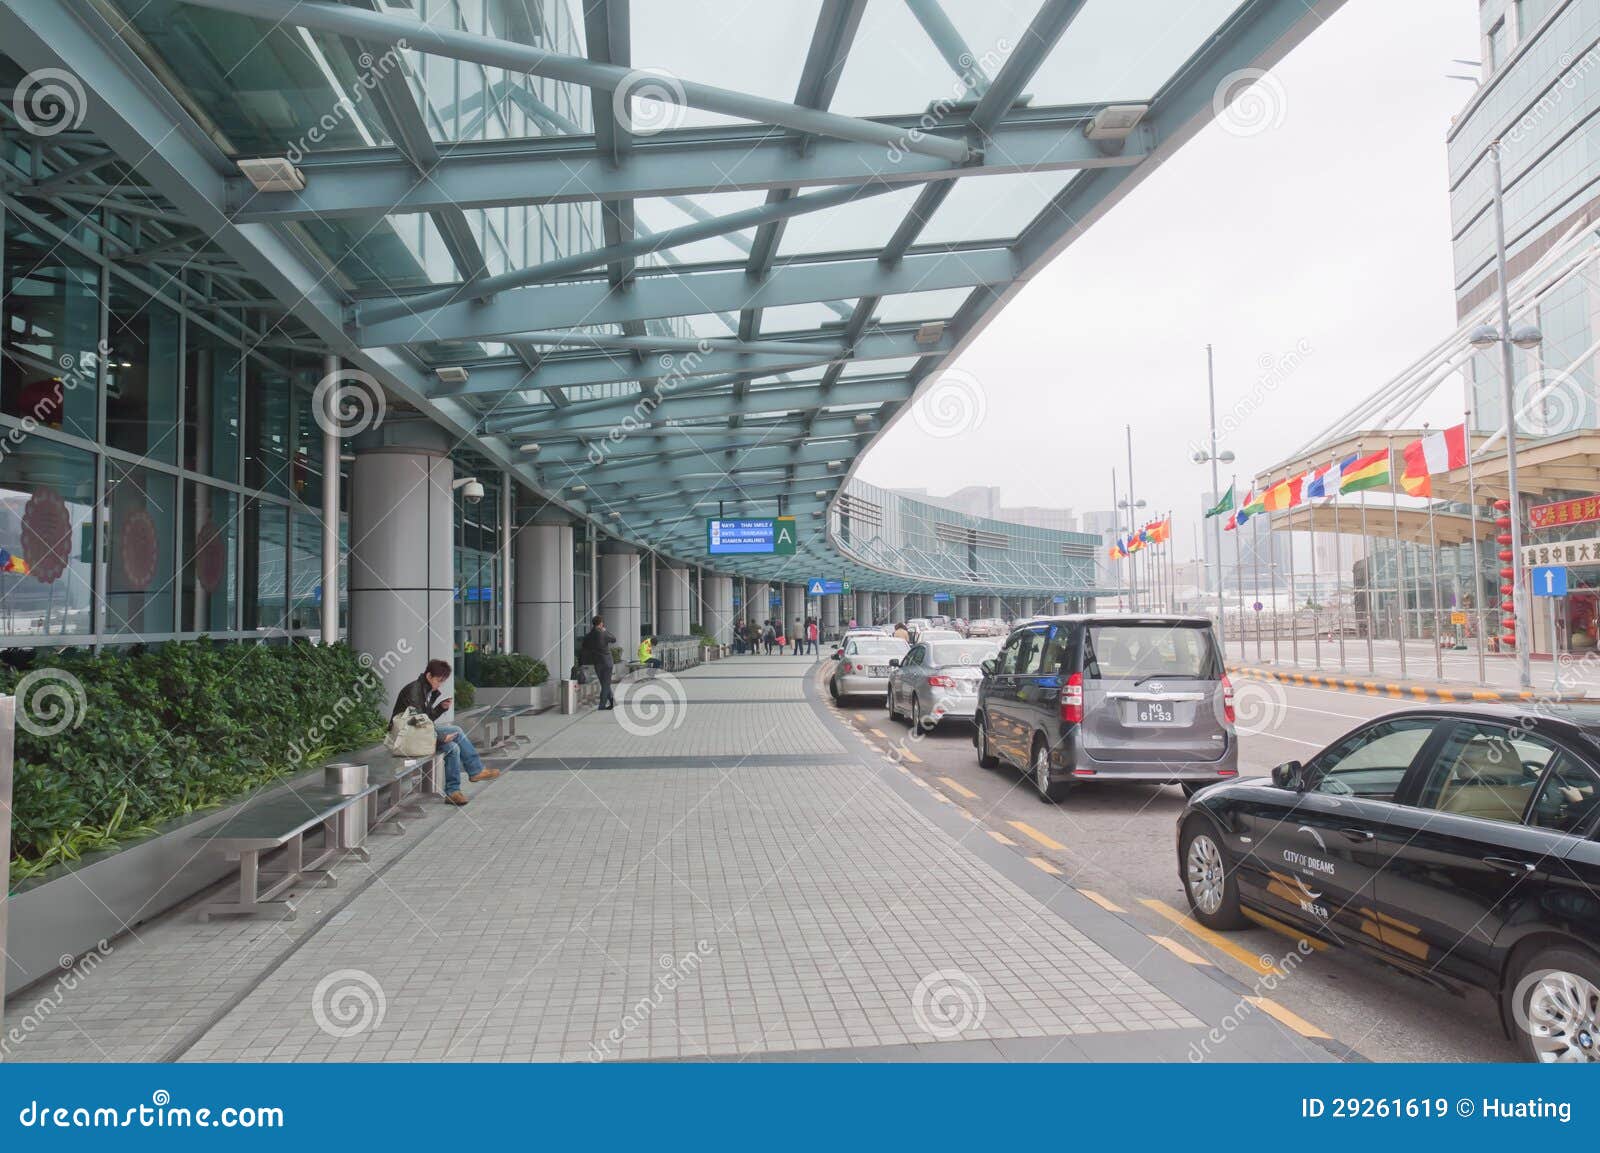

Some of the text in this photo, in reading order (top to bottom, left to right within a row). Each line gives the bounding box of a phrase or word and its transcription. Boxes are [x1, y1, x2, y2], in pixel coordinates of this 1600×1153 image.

[777, 527, 792, 544] A
[1140, 712, 1172, 722] 61-53
[1283, 849, 1299, 864] CITY
[1298, 854, 1308, 868] OF
[1307, 856, 1335, 875] DREAMS
